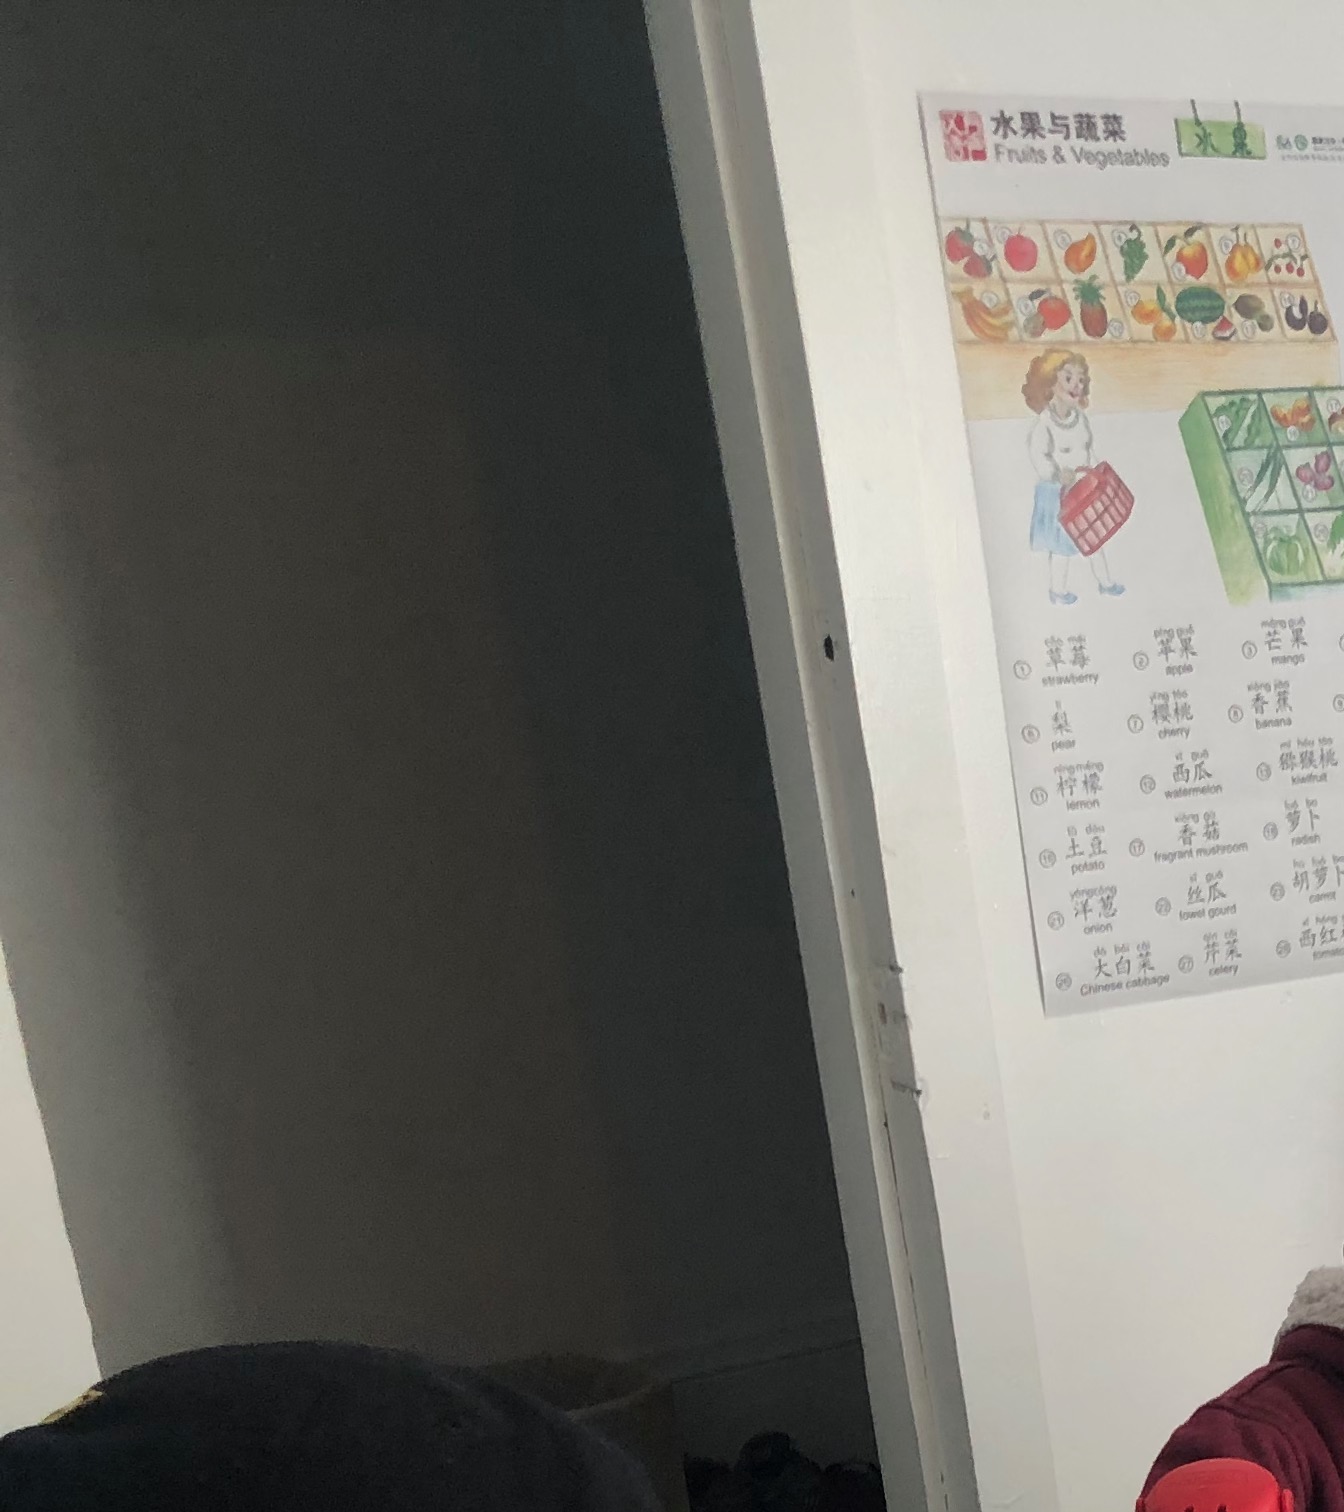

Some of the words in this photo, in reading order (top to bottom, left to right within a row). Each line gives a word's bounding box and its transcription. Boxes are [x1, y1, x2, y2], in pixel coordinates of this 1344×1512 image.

[991, 109, 1127, 142] 水果与蔬菜
[993, 143, 1047, 164] Fruits
[1053, 145, 1066, 164] &
[1071, 146, 1170, 171] Vegetables
[1264, 627, 1308, 652] 芒果
[1172, 760, 1213, 784] 西瓜
[1164, 783, 1223, 799] watermelon
[1066, 799, 1100, 812] lemon
[1065, 835, 1108, 860] 土豆
[1071, 861, 1105, 876] potato
[1083, 922, 1113, 936] onion
[1094, 951, 1155, 980] 大白菜
[1208, 963, 1239, 978] celery
[1080, 981, 1123, 997] Chinese
[1125, 973, 1170, 990] cabbage
